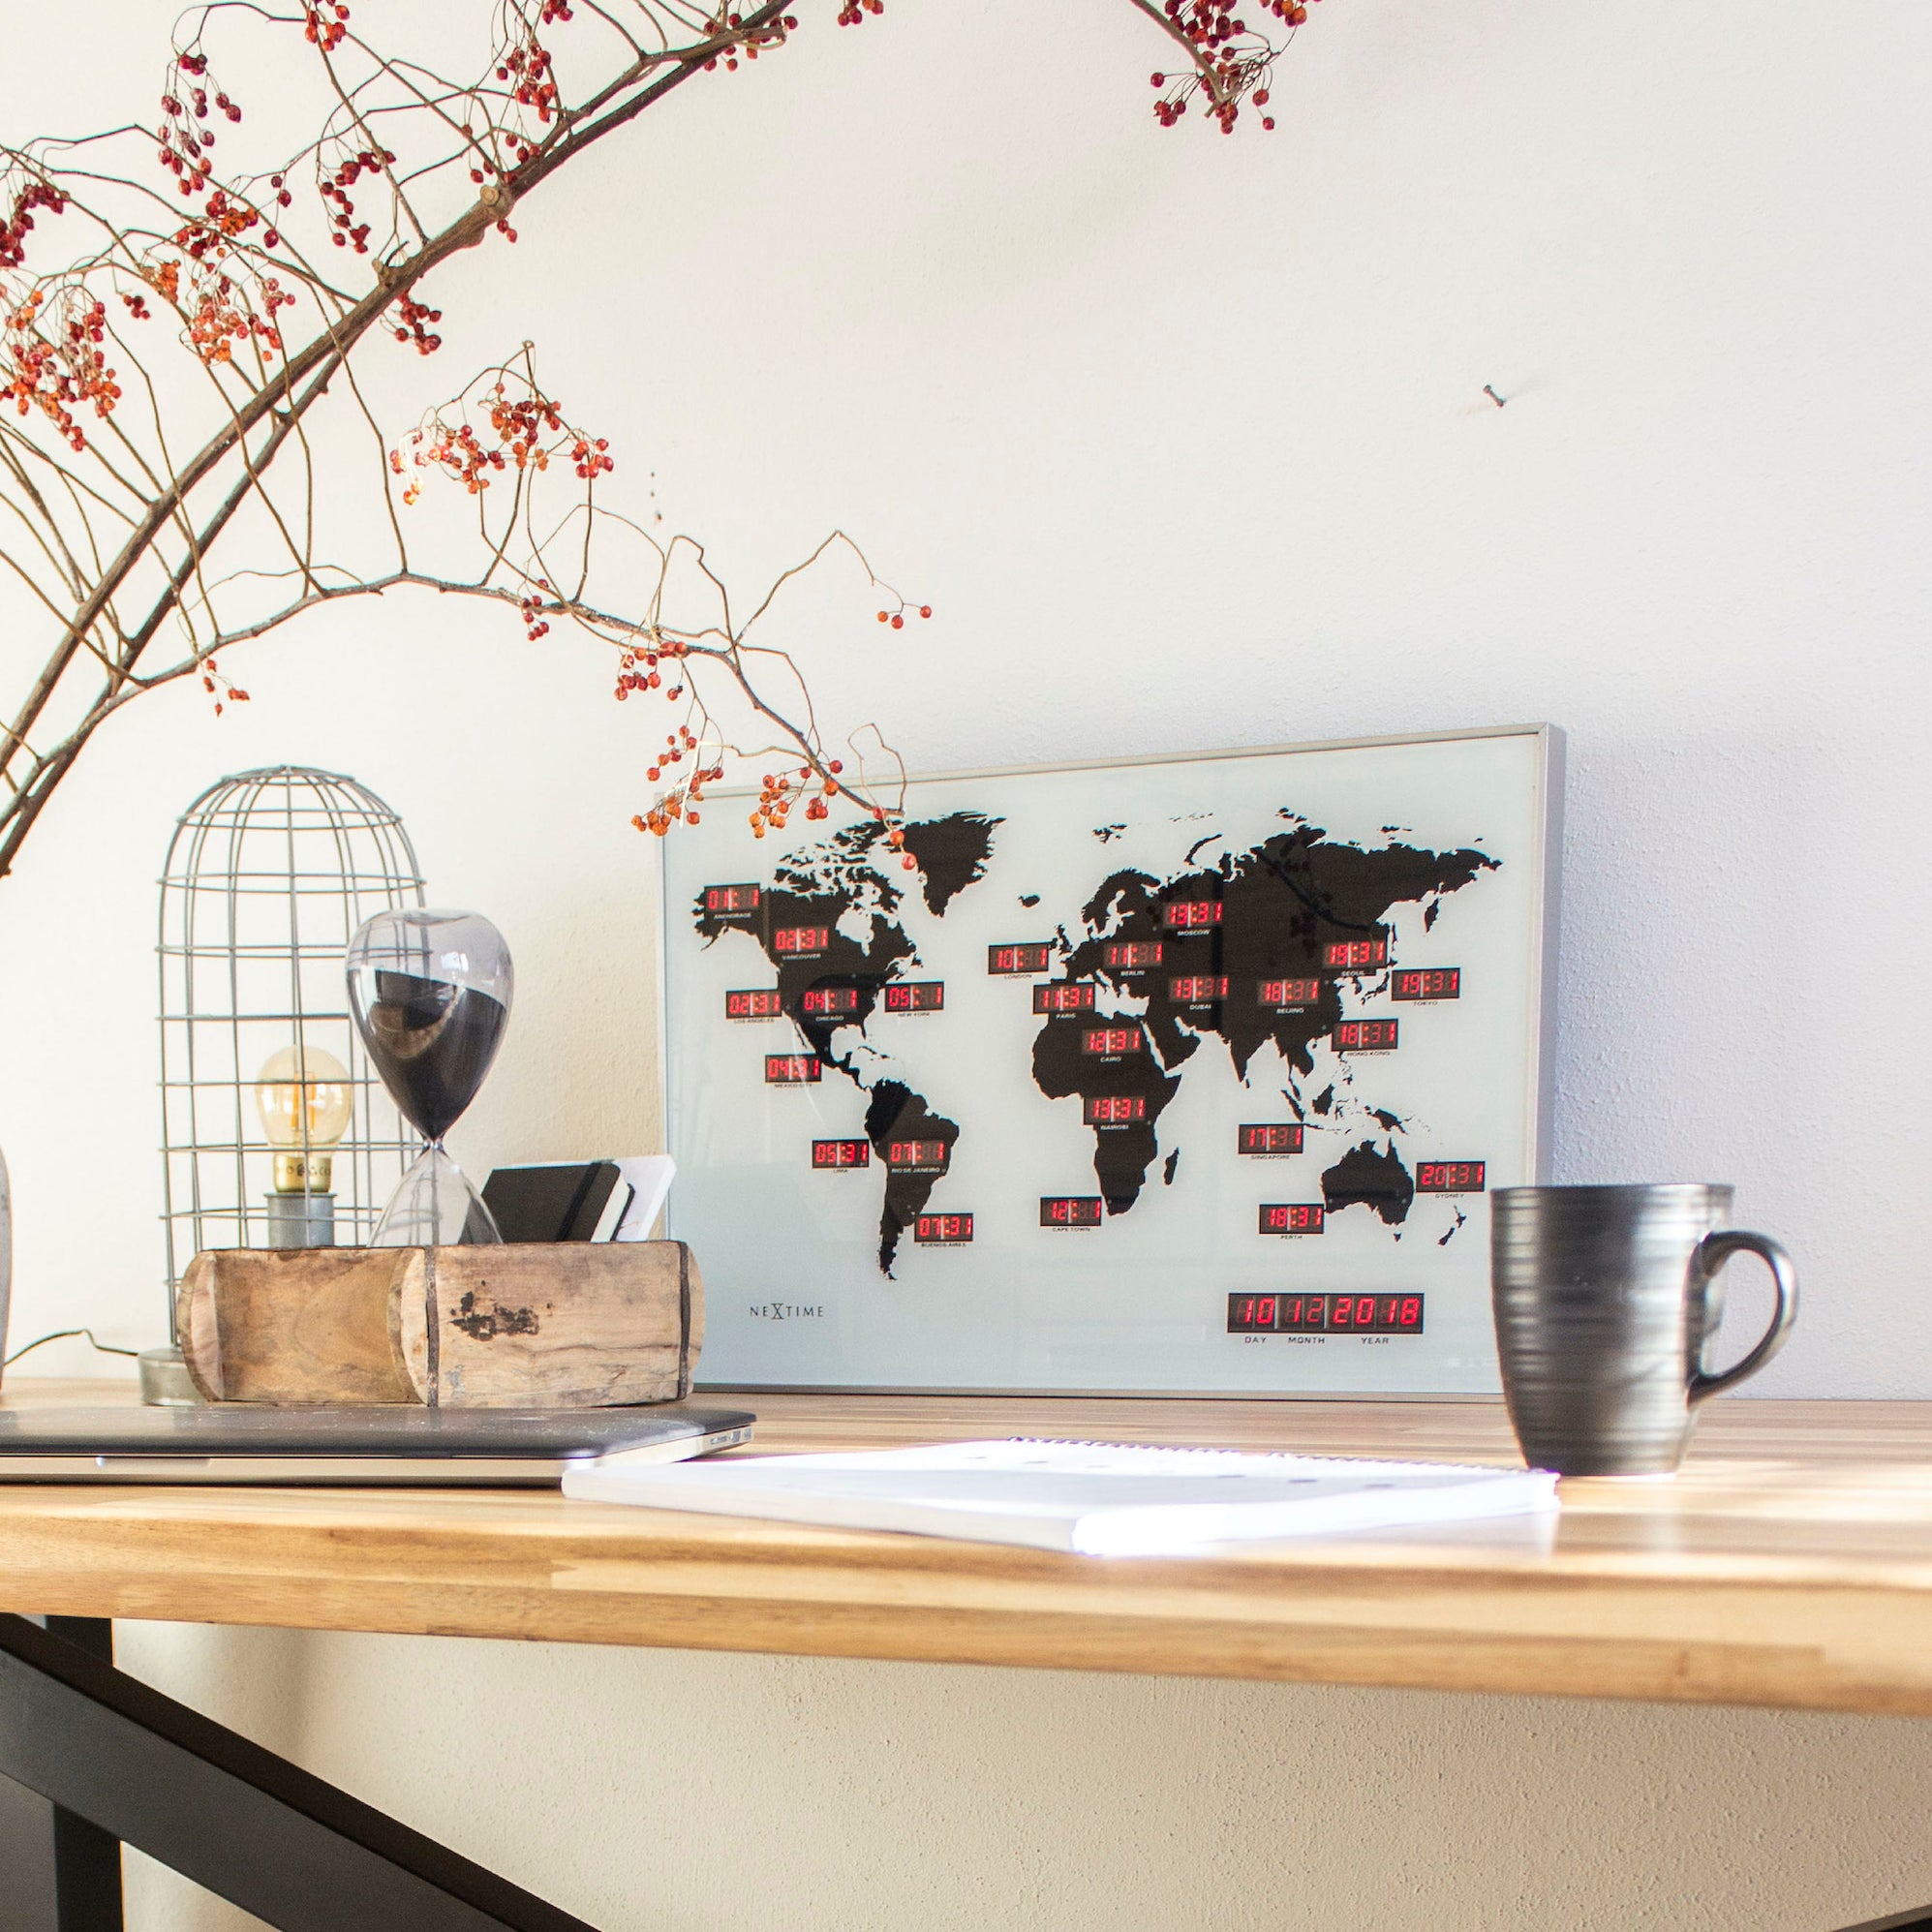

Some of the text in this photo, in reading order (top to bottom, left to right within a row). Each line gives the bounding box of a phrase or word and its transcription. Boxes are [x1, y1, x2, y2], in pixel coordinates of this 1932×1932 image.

[1171, 903, 1222, 925] 13:31
[776, 929, 828, 950] 02:31
[1330, 941, 1384, 965] 19:31
[1401, 971, 1458, 994] 19:31
[729, 995, 781, 1014] 02:31
[1043, 987, 1092, 1008] 11:31
[1089, 1030, 1140, 1052] 12:31
[1341, 1023, 1396, 1044] 18:31
[1093, 1098, 1145, 1119] 13:31
[815, 1144, 868, 1162] 05:31
[1422, 1164, 1484, 1185] 20:31
[919, 1216, 972, 1236] 07:31
[1270, 1207, 1323, 1227] 18:31
[750, 1303, 824, 1320] NEXTIME
[1243, 1298, 1421, 1324] 10 12 2018
